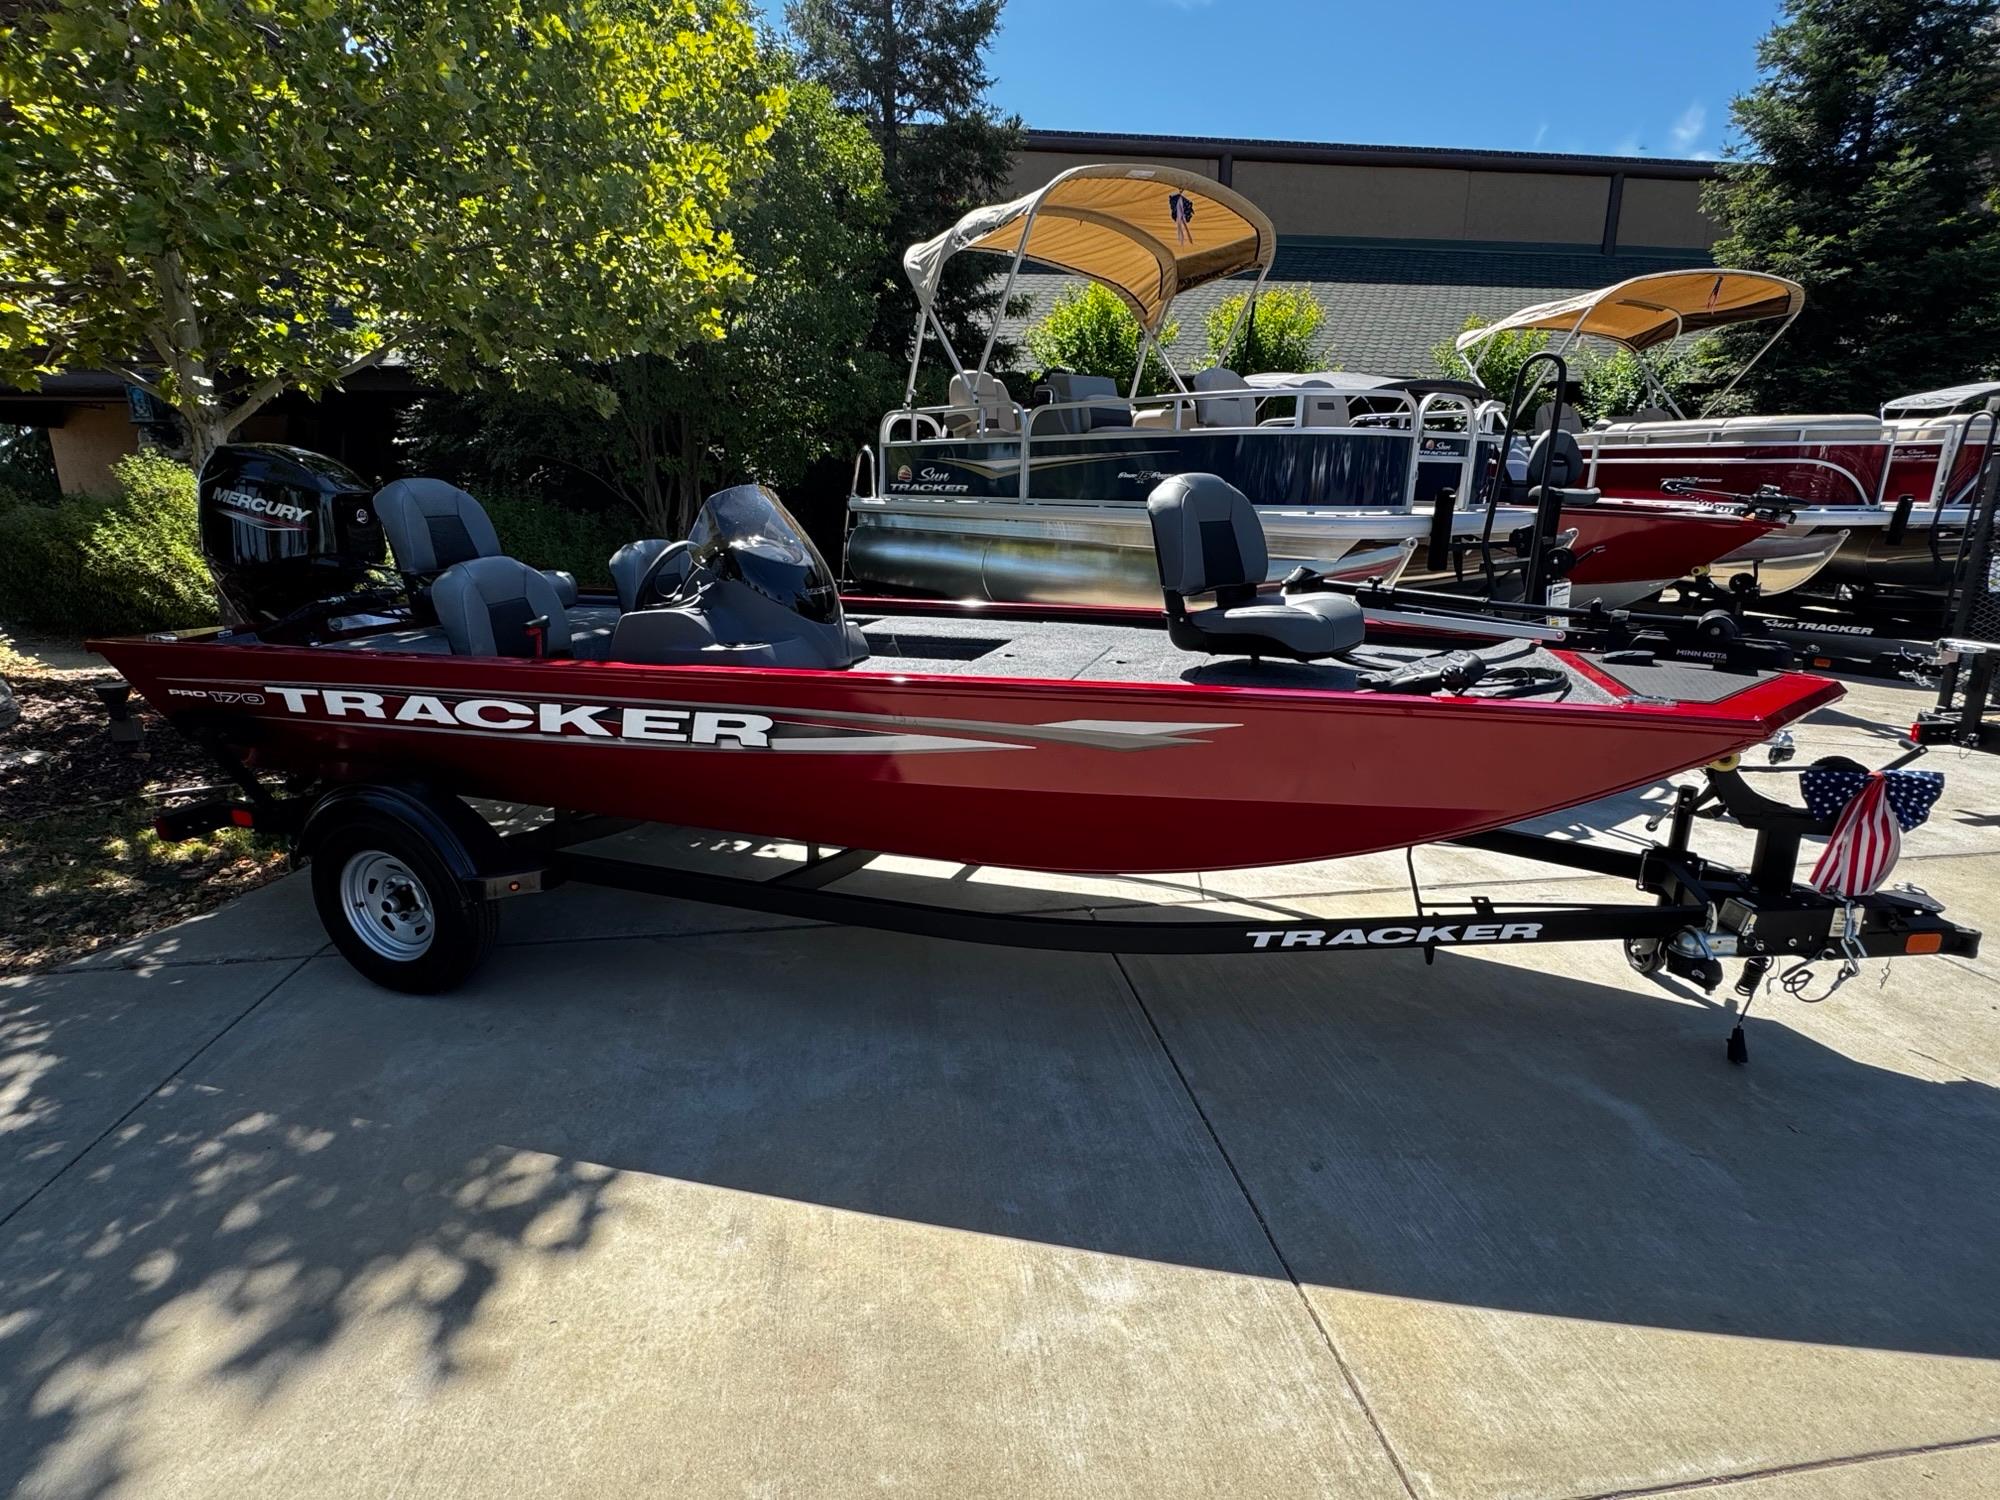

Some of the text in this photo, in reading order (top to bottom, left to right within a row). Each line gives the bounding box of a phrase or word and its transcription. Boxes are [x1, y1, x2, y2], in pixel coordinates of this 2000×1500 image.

[918, 467, 950, 481] Sun
[890, 483, 969, 493] TRACKER
[212, 486, 312, 522] MERCURY
[1761, 618, 1874, 635] Sun TRACKER
[1676, 649, 1727, 659] MINN KOTA
[168, 686, 774, 748] PRO 170 TRACKER
[1246, 923, 1543, 948] TRACKER
